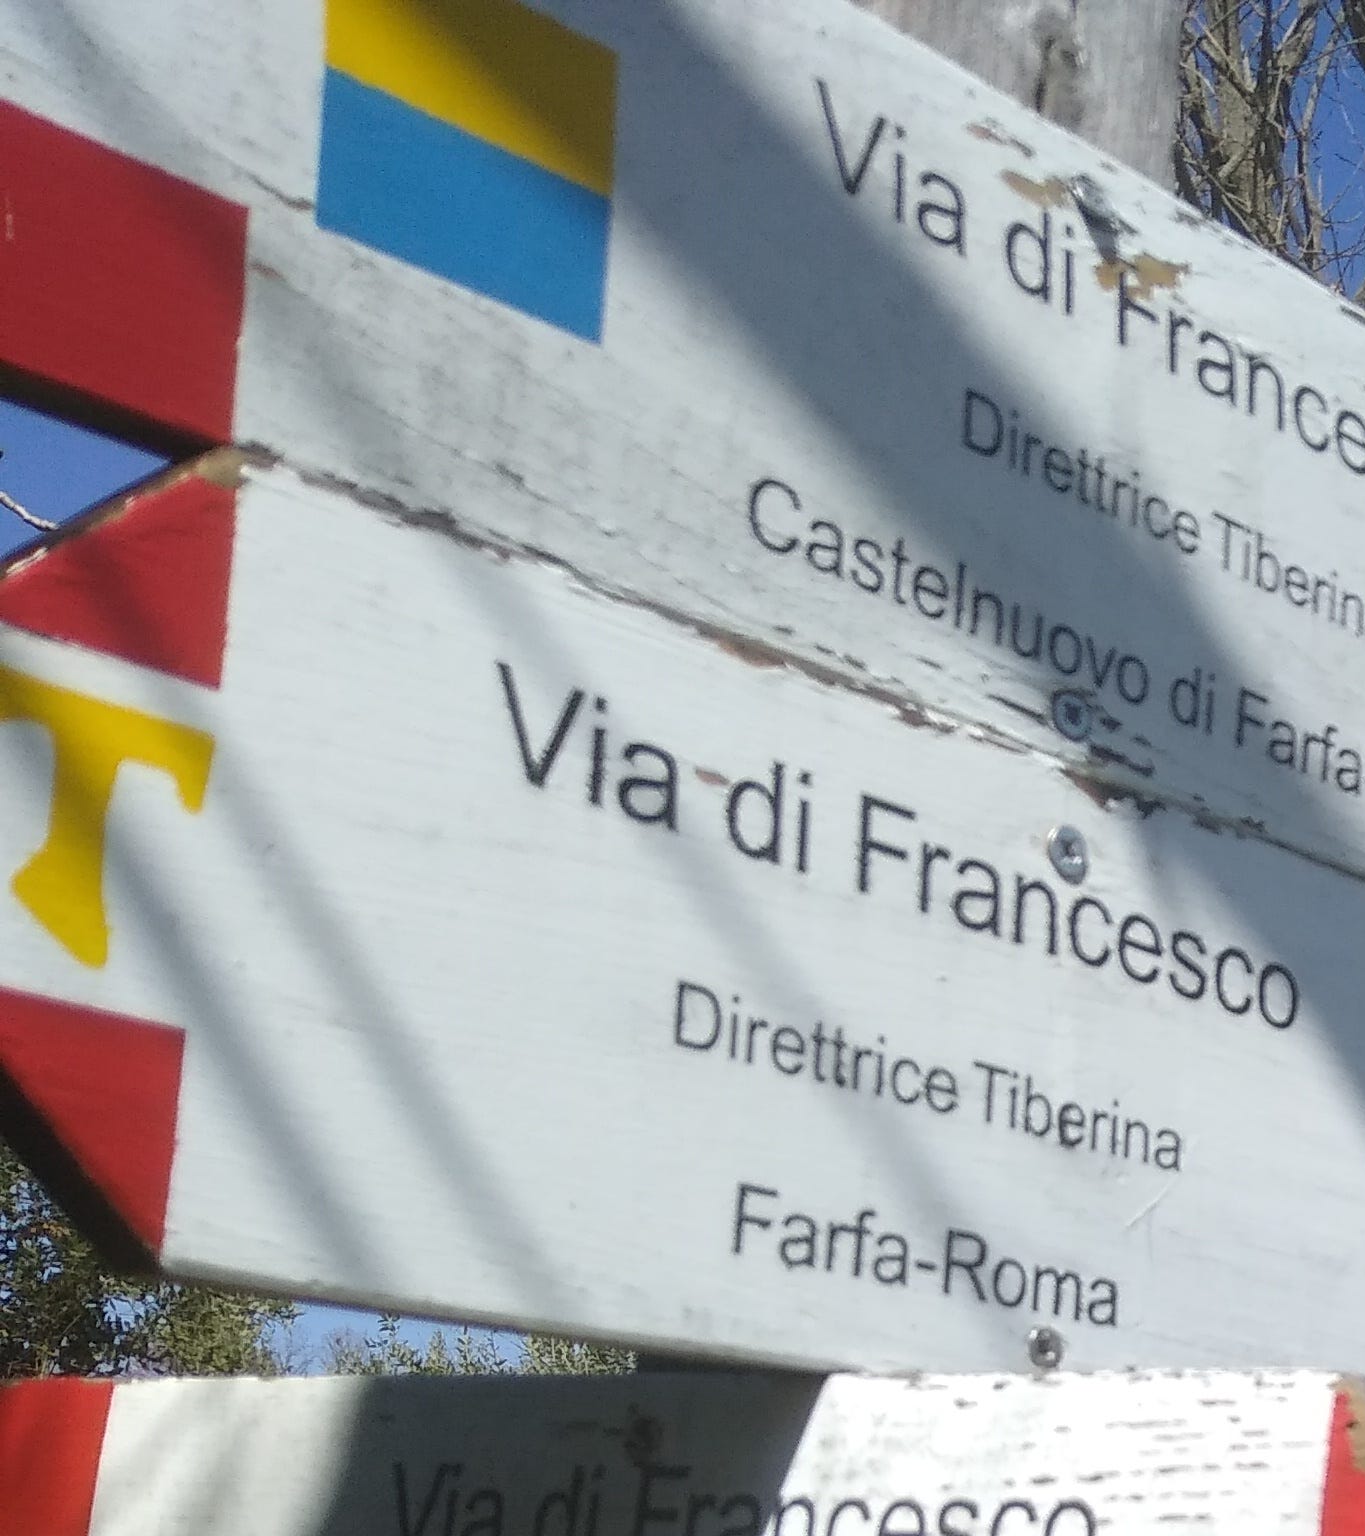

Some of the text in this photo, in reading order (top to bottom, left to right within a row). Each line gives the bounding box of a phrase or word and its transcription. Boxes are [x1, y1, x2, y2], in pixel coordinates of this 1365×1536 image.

[814, 75, 967, 258] Via
[1006, 204, 1076, 315] di
[962, 386, 1200, 554] Direttrice
[747, 477, 1149, 705] Castelnuovo
[1170, 668, 1217, 736] di
[495, 661, 1300, 1031] Via di Francesco
[673, 980, 1184, 1173] Direttrice Tiberina
[730, 1182, 1119, 1327] Farfa-Roma
